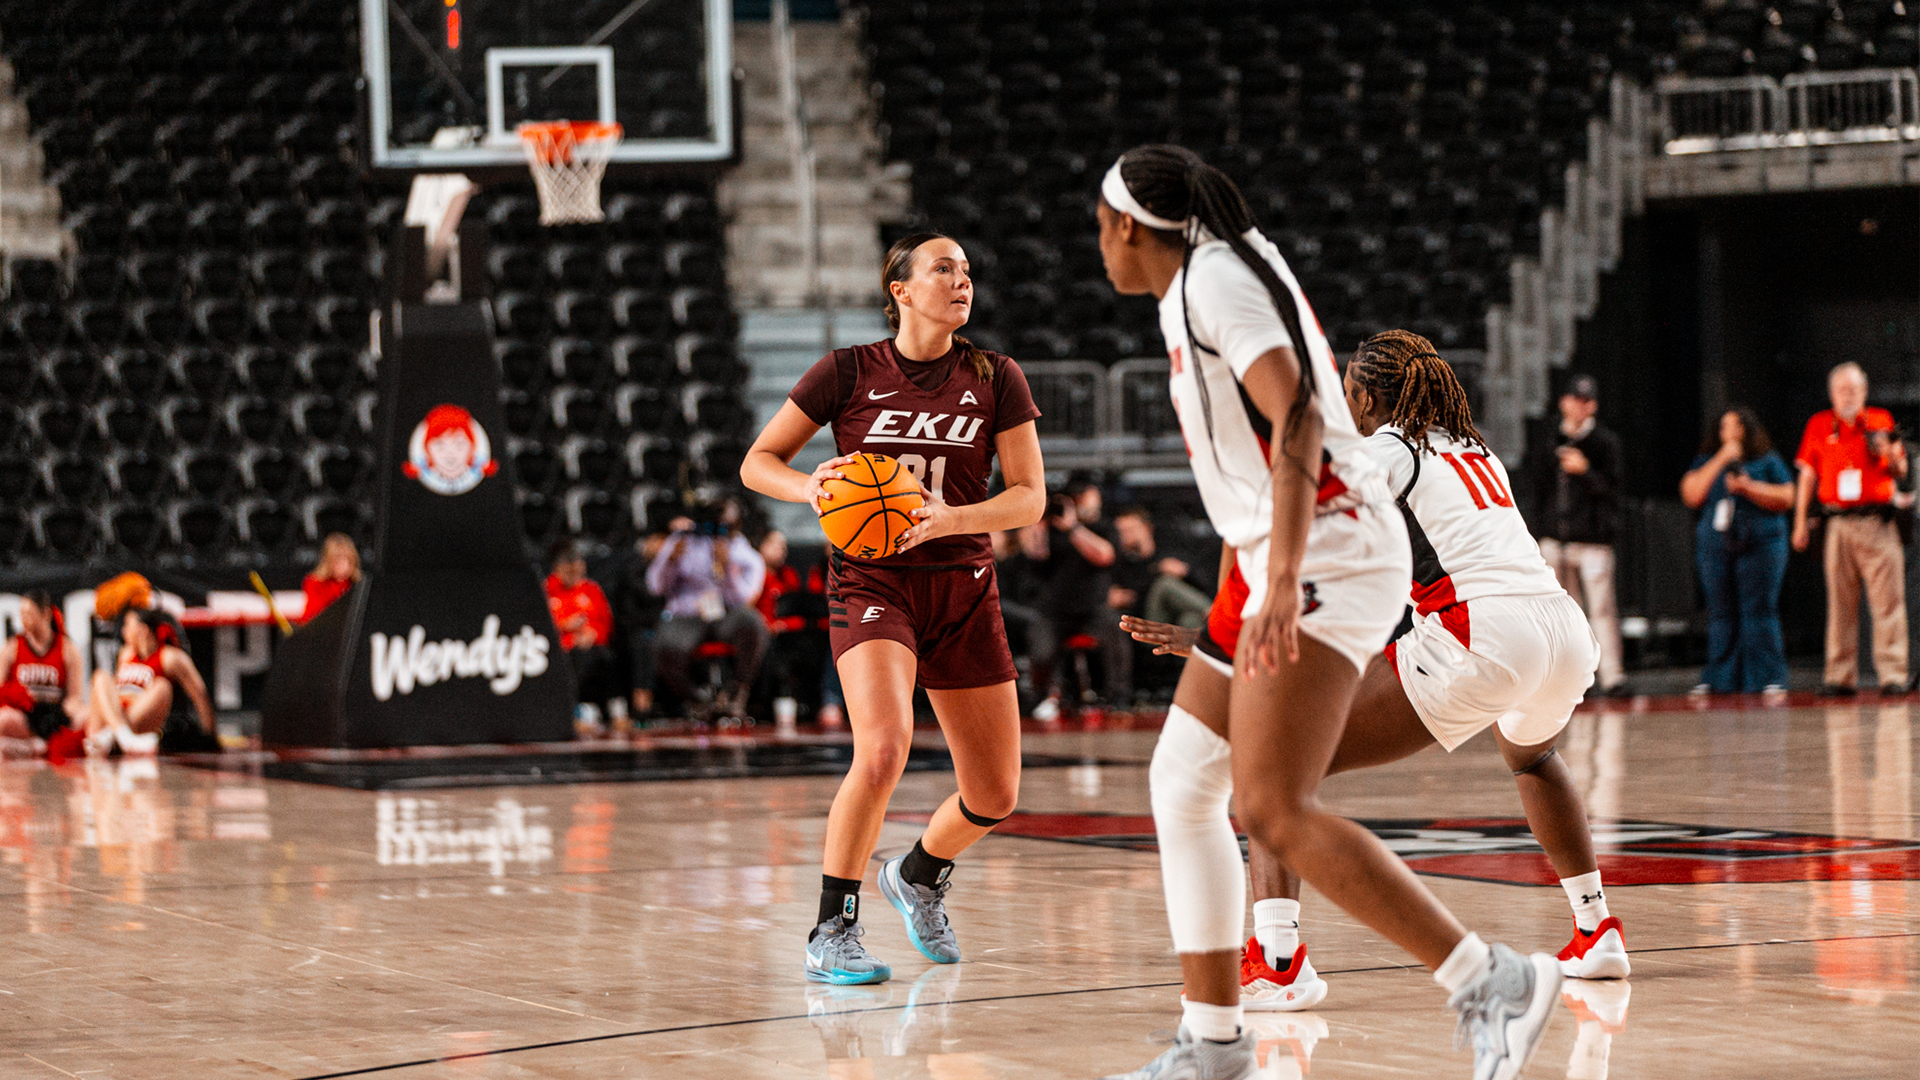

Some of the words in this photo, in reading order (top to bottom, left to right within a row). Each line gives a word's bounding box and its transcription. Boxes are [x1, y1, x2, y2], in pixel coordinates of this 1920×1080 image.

[866, 410, 984, 444] EKU
[1440, 452, 1514, 510] 10
[862, 606, 885, 622] E
[370, 613, 550, 701] Wendy's
